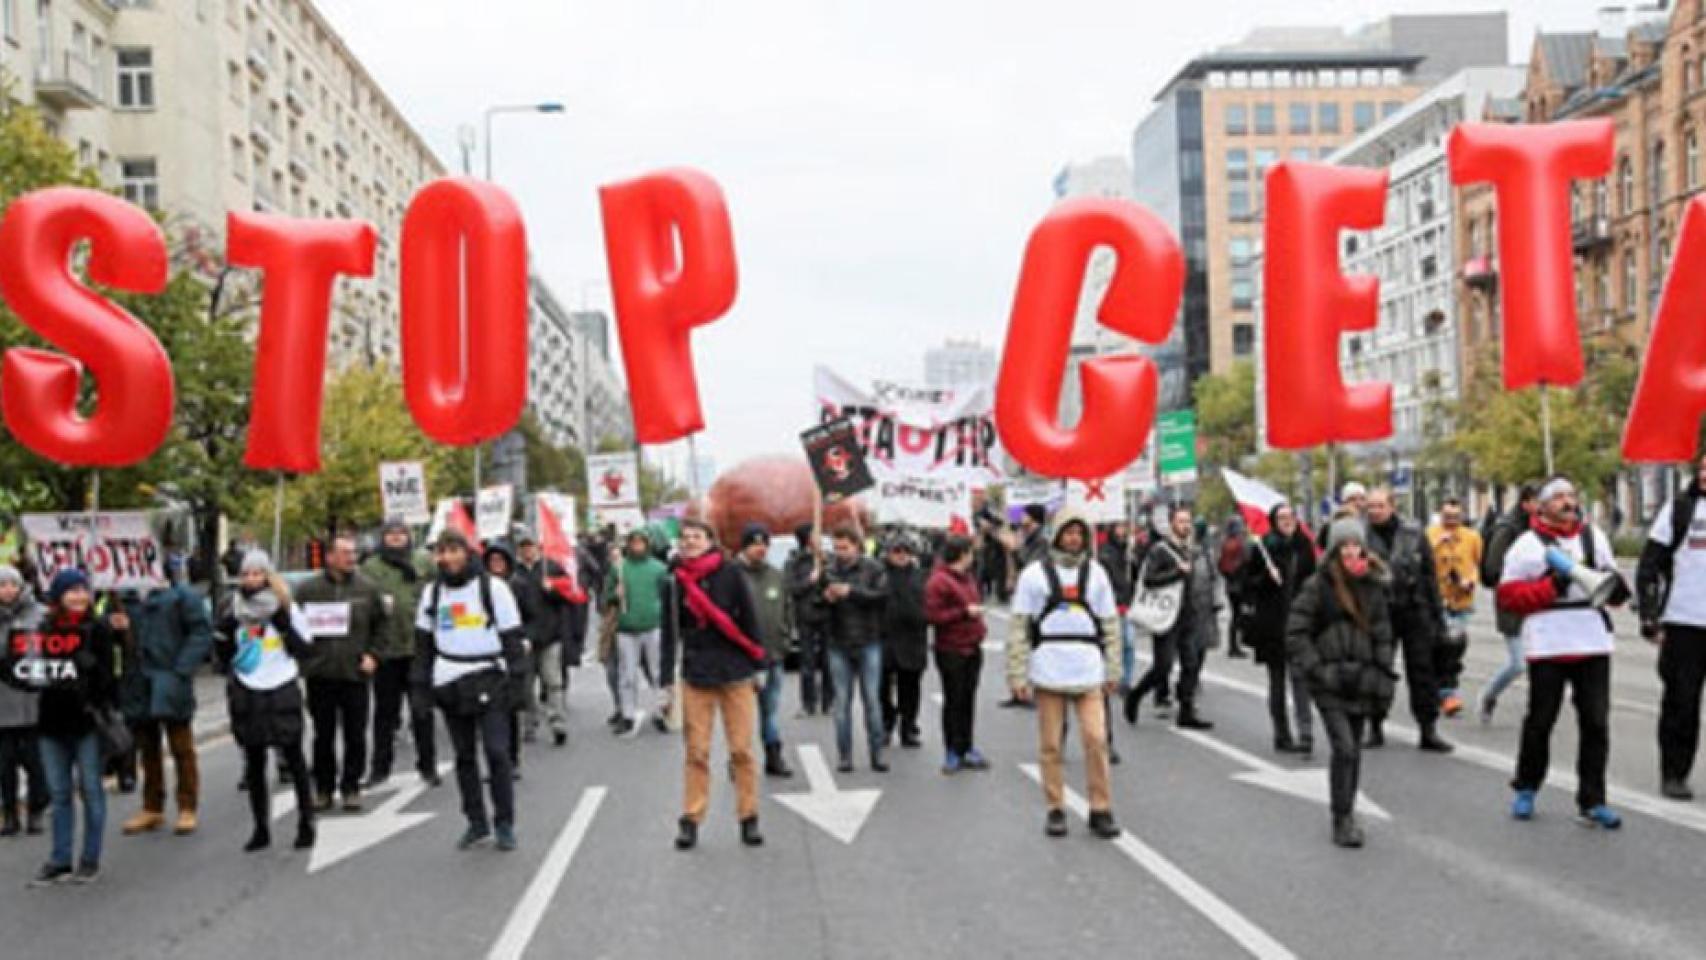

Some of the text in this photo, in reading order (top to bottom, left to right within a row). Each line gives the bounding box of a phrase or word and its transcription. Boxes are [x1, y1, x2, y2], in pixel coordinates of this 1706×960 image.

[0, 166, 739, 473] STOP
[13, 633, 81, 655] STOP
[13, 658, 78, 680] CETA
